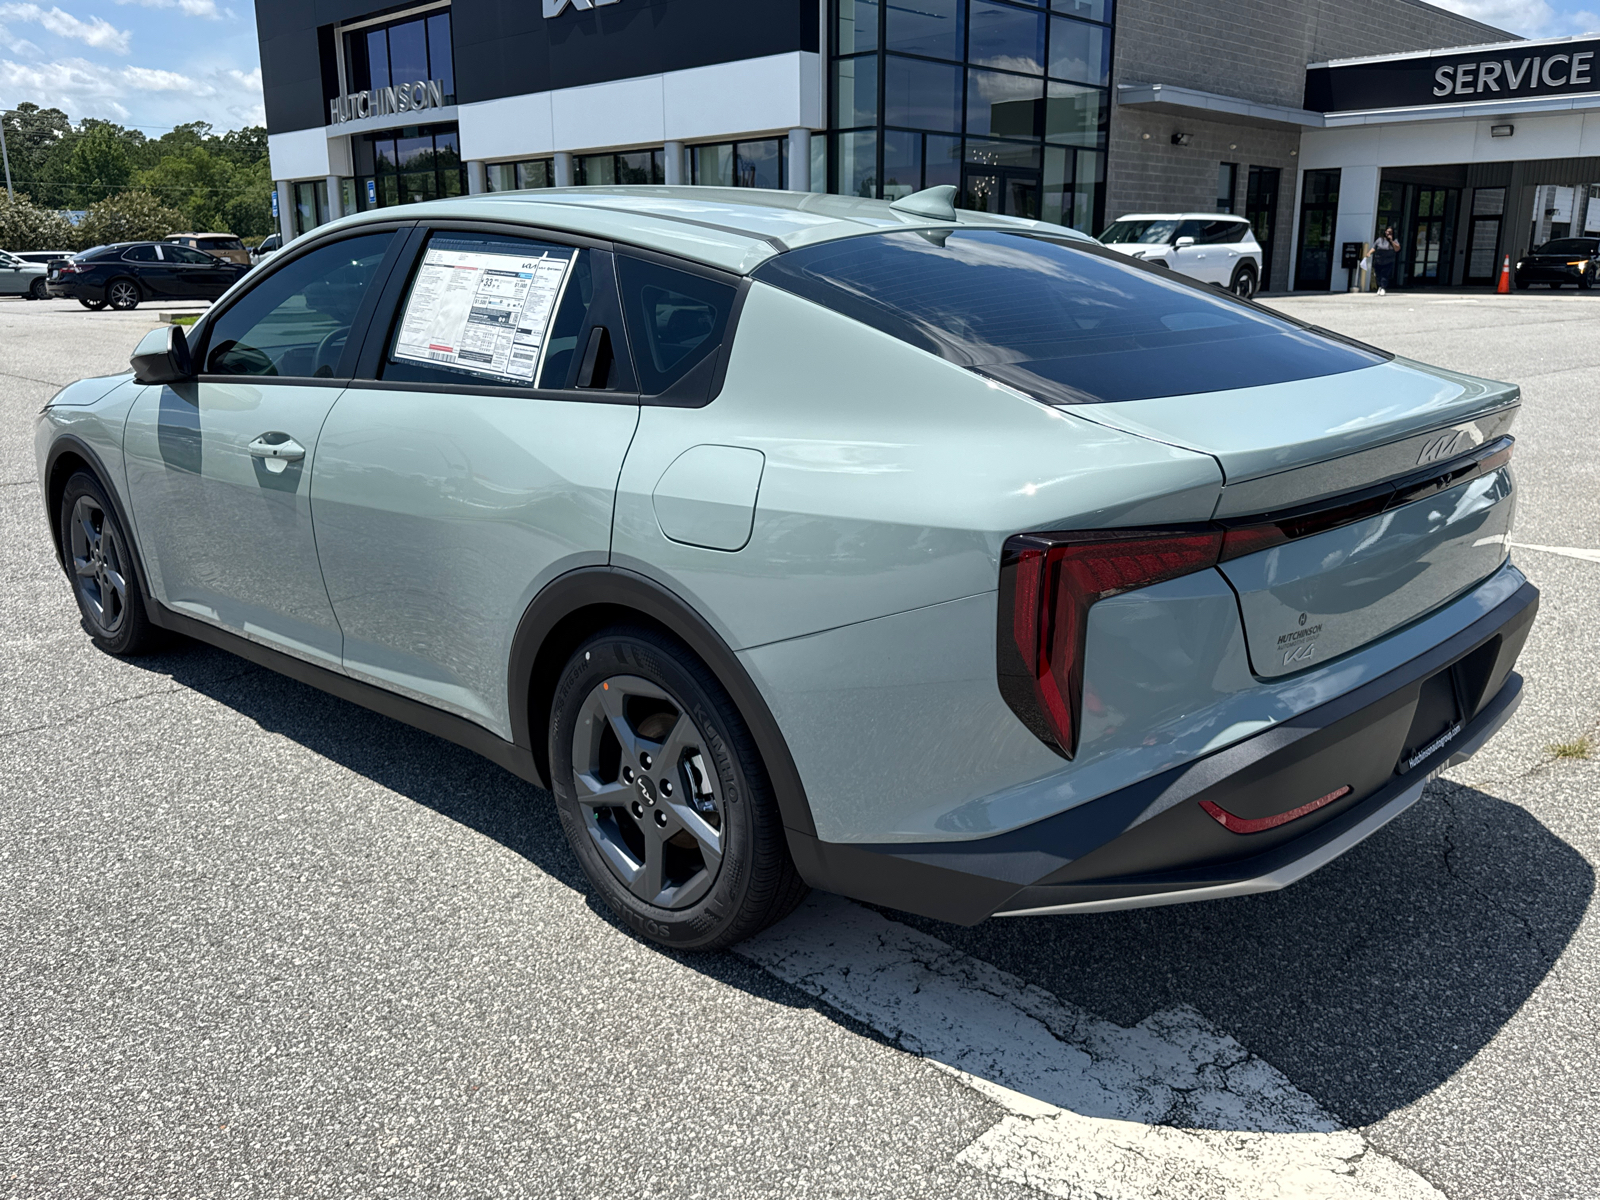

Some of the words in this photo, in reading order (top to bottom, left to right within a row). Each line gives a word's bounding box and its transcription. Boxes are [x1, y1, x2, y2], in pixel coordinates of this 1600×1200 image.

[1433, 52, 1594, 97] SERVICE
[330, 79, 443, 126] HUTCHINSON
[483, 277, 494, 287] 33
[1277, 623, 1323, 644] HUTCHINSON
[1282, 643, 1315, 666] K4
[563, 676, 575, 698] R16
[573, 660, 590, 679] 91H
[694, 703, 739, 804] KUMHO
